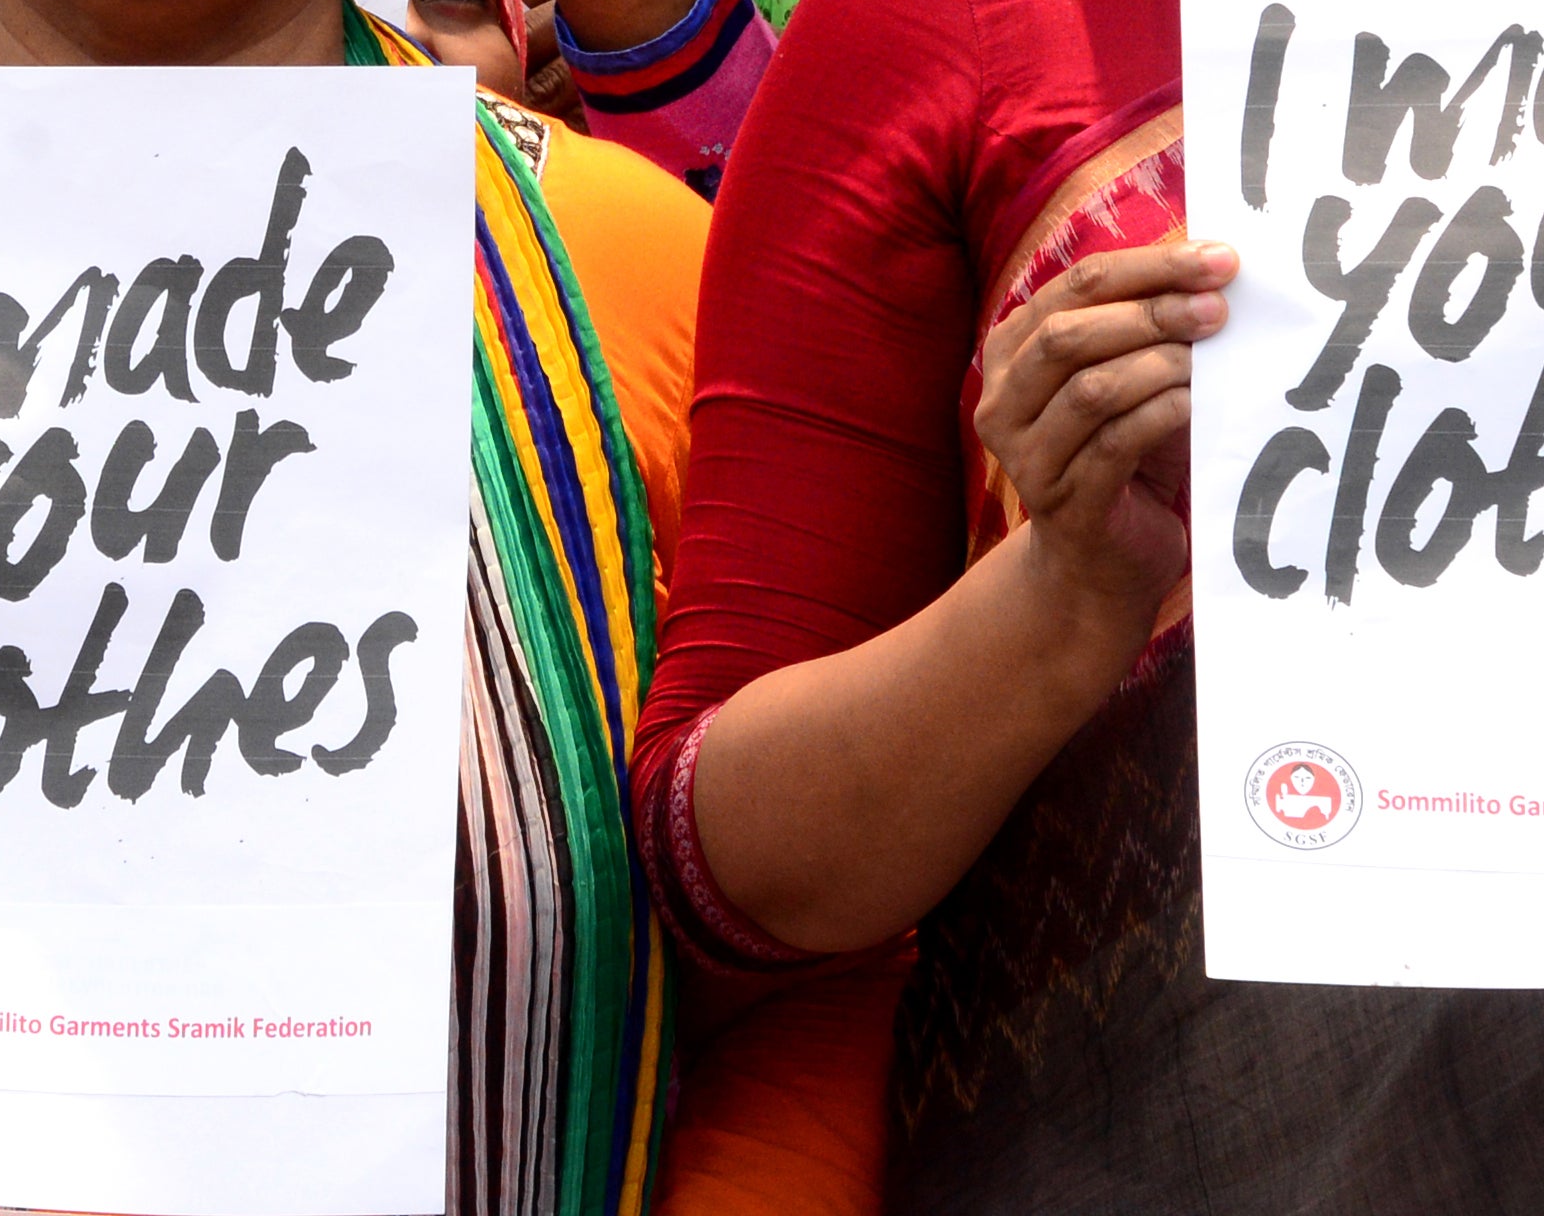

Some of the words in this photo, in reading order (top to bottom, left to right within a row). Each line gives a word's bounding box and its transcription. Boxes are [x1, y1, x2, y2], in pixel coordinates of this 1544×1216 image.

[1242, 3, 1296, 213] I
[1377, 789, 1501, 816] Sommilito
[49, 1015, 161, 1038] Garments
[167, 1017, 245, 1039] Sramik
[253, 1016, 373, 1038] Federation
